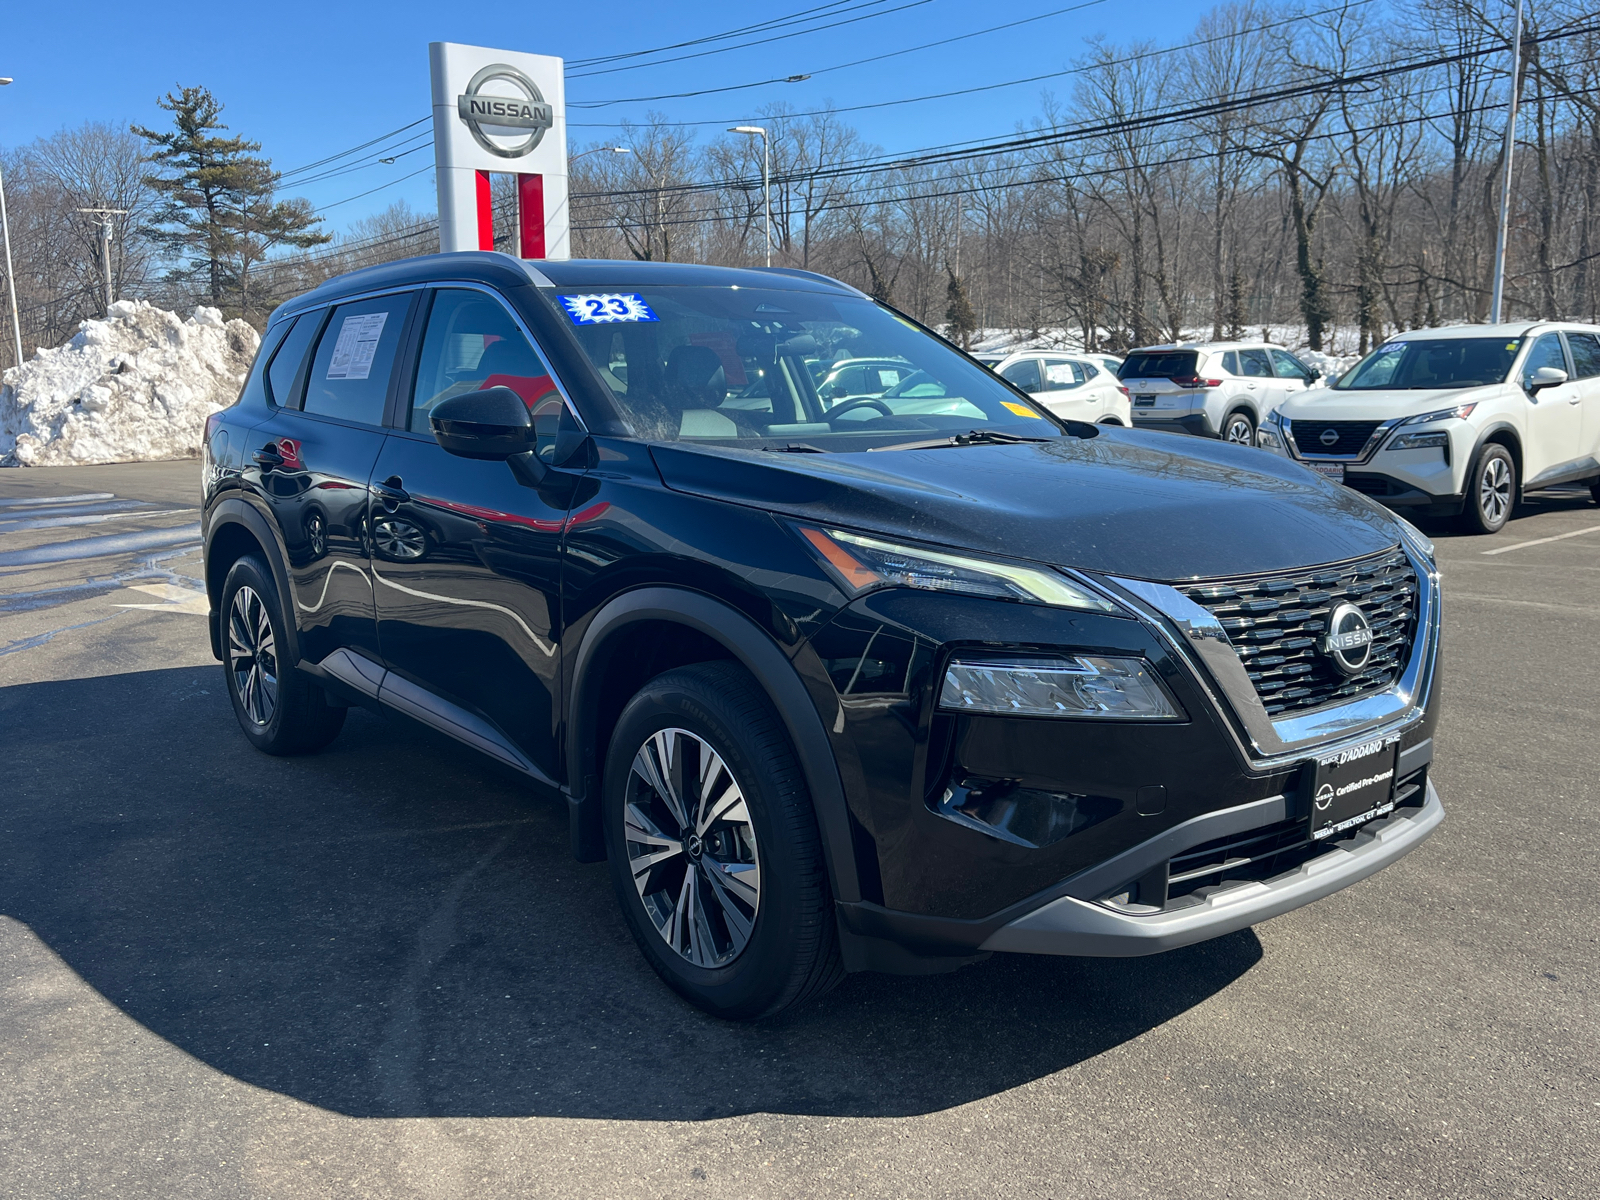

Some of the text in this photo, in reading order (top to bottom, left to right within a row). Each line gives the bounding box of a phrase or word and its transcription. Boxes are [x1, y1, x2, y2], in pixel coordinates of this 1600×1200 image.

[470, 100, 546, 121] NISSAN
[585, 298, 630, 317] 23
[1329, 631, 1373, 648] NISSAN
[680, 699, 741, 762] Dynapro
[1321, 755, 1340, 766] BUICK
[1340, 741, 1382, 764] D'ADDARIO
[1336, 768, 1394, 797] Certified Pre-Owned
[1315, 792, 1334, 801] NISSAN
